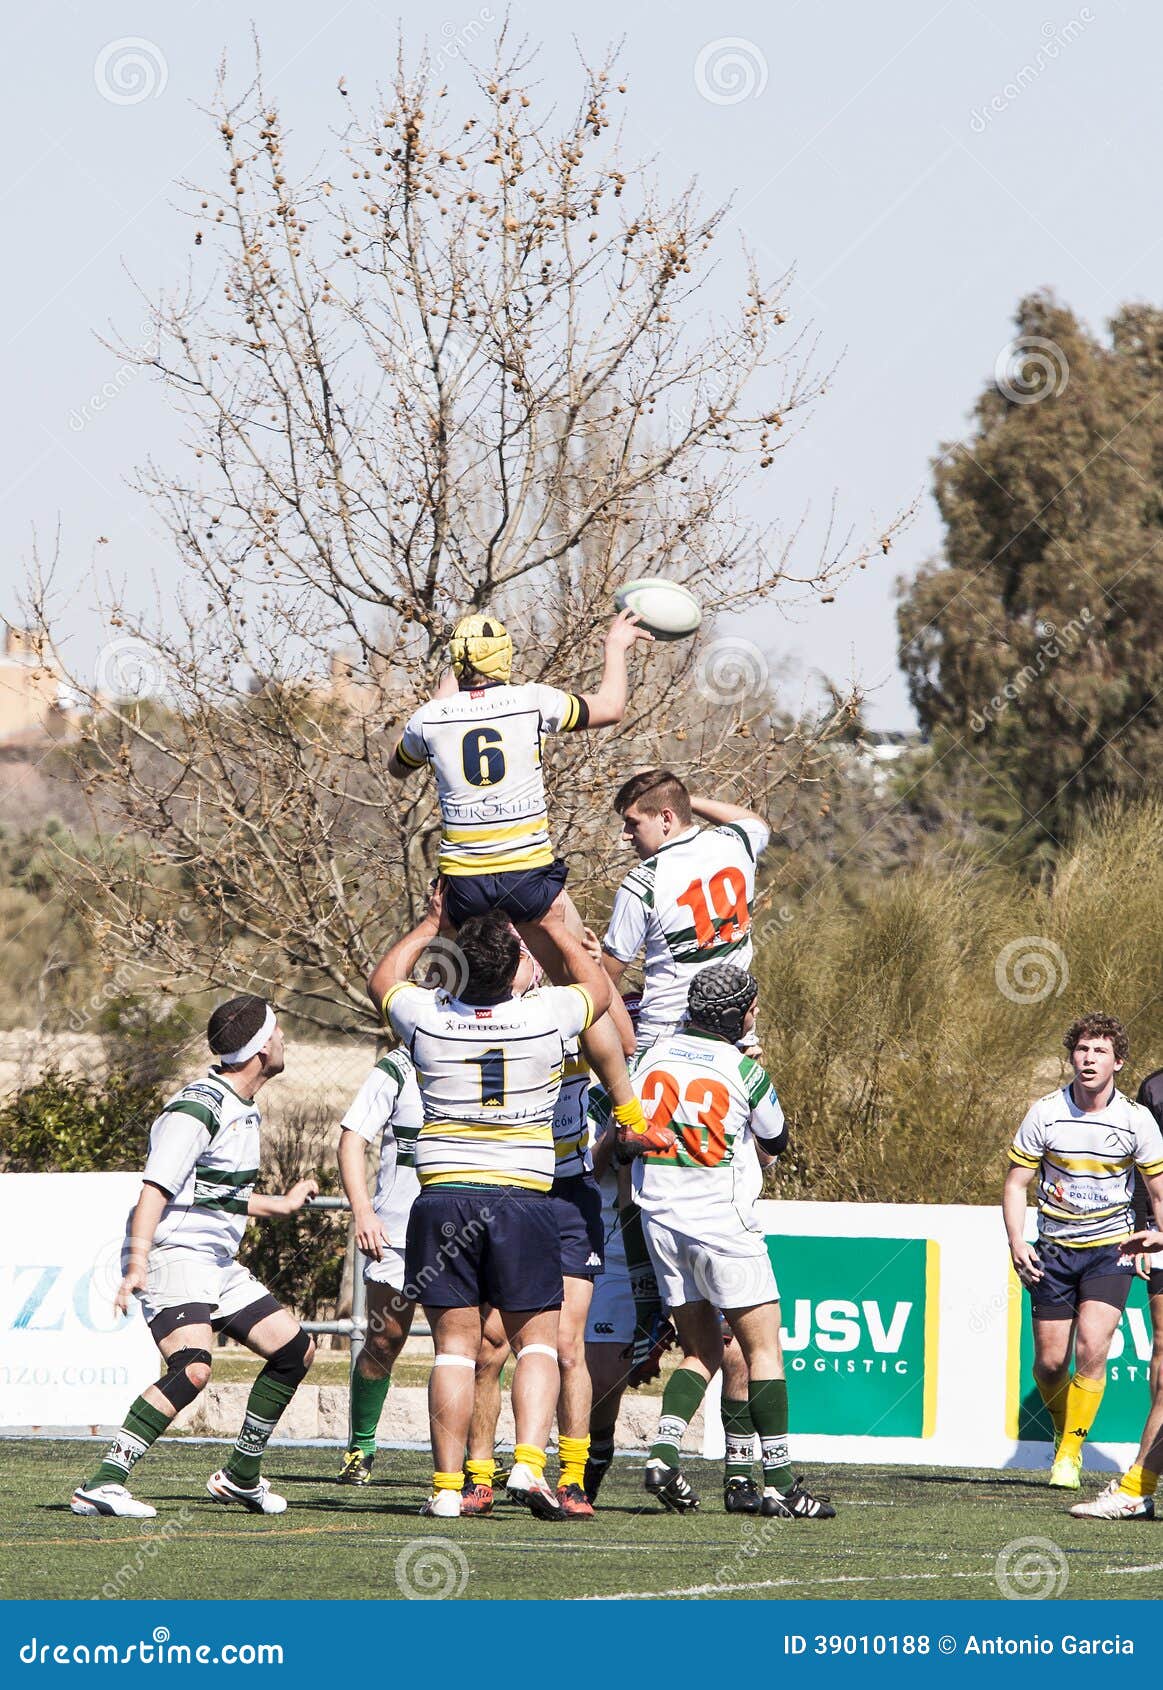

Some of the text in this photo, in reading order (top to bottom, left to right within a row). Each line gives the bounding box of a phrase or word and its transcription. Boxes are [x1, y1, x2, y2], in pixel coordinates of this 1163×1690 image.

[461, 726, 507, 788] 6
[676, 866, 751, 949] 19
[464, 1048, 506, 1107] 1
[552, 1113, 573, 1129] CÓN
[641, 1070, 730, 1167] 23
[778, 1299, 913, 1354] JSV
[791, 1357, 908, 1375] OGISTIC
